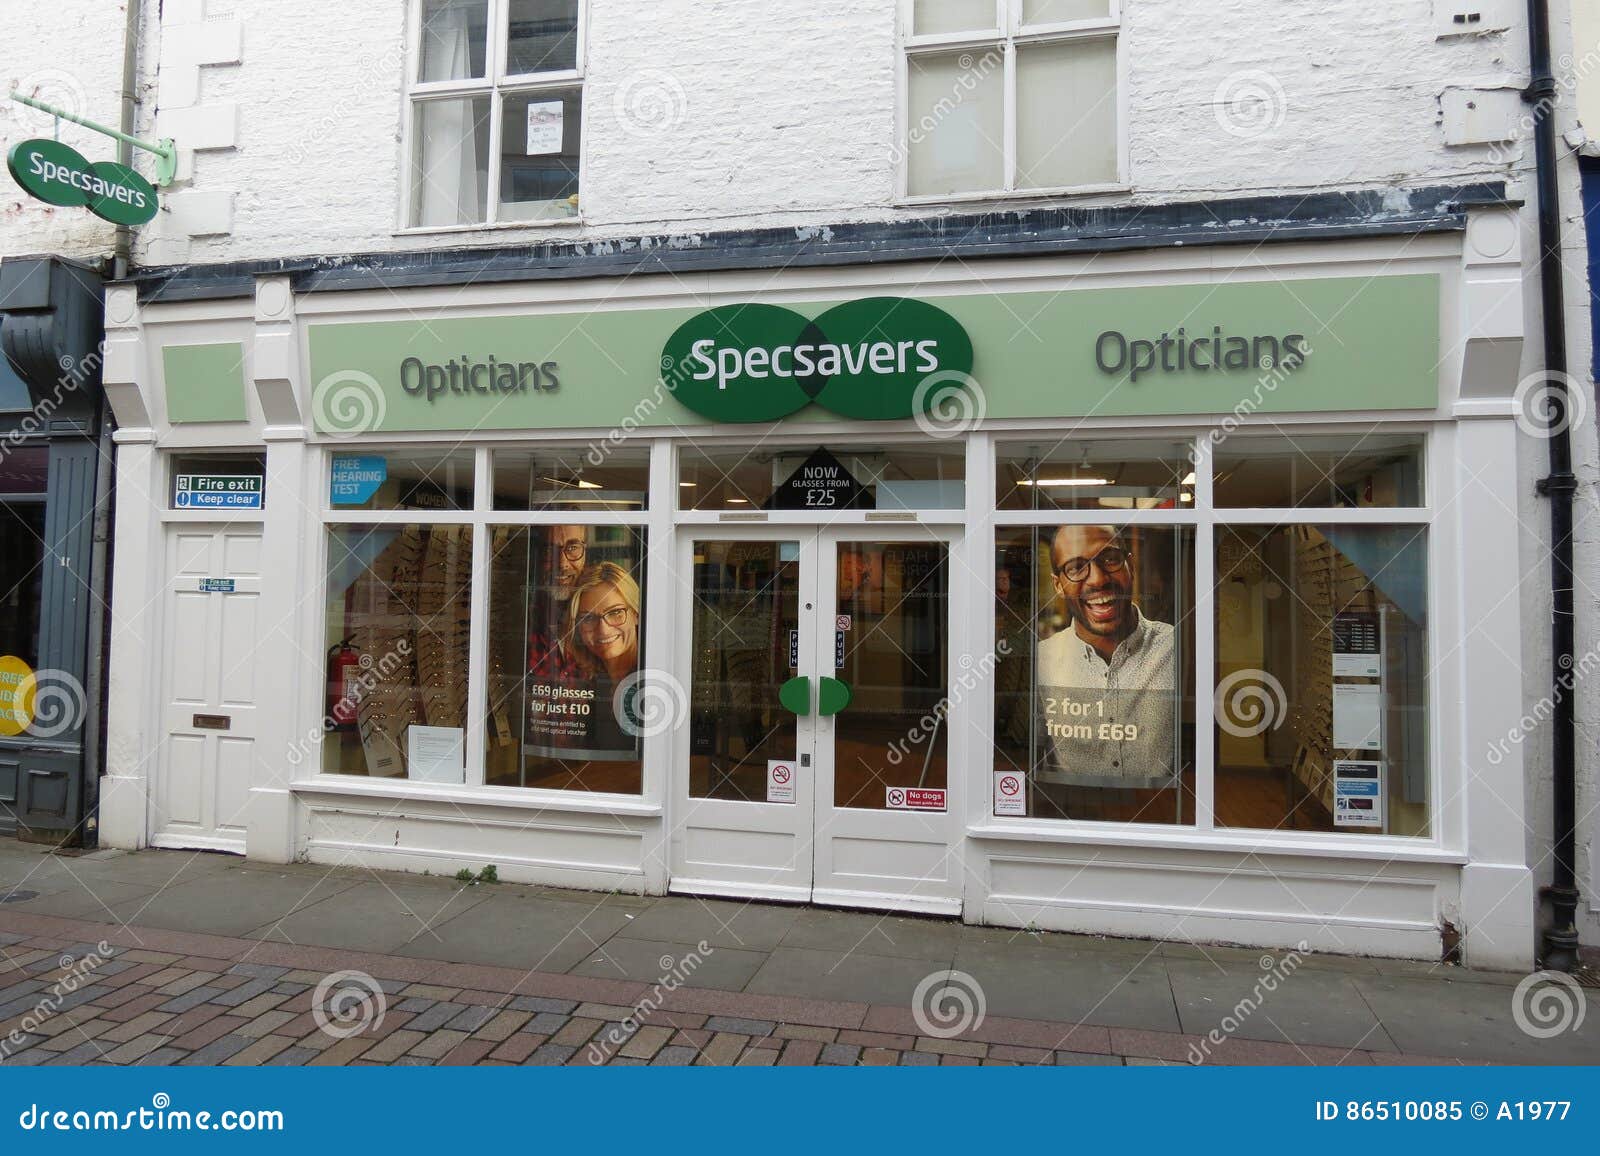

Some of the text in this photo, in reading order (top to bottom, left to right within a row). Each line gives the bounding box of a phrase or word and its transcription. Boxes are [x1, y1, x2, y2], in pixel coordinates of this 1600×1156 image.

[30, 151, 146, 208] Specsavers
[1095, 325, 1306, 383] Opticians
[691, 339, 938, 390] Specsavers
[400, 354, 561, 402] Opticians
[333, 458, 360, 470] FREE
[332, 470, 382, 482] HEARING
[804, 466, 838, 479] NOW
[197, 478, 255, 490] Fire exit
[332, 483, 360, 495] TEST
[792, 479, 850, 488] GLASSES FROM
[197, 493, 255, 506] Keep clear
[415, 493, 449, 507] WOMEN
[805, 489, 836, 506] £25
[532, 684, 595, 700] £69 glasses
[531, 700, 590, 715] for just £10
[1045, 697, 1105, 717] 2 for 1
[1045, 719, 1138, 741] from £69
[909, 791, 942, 801] No dogs
